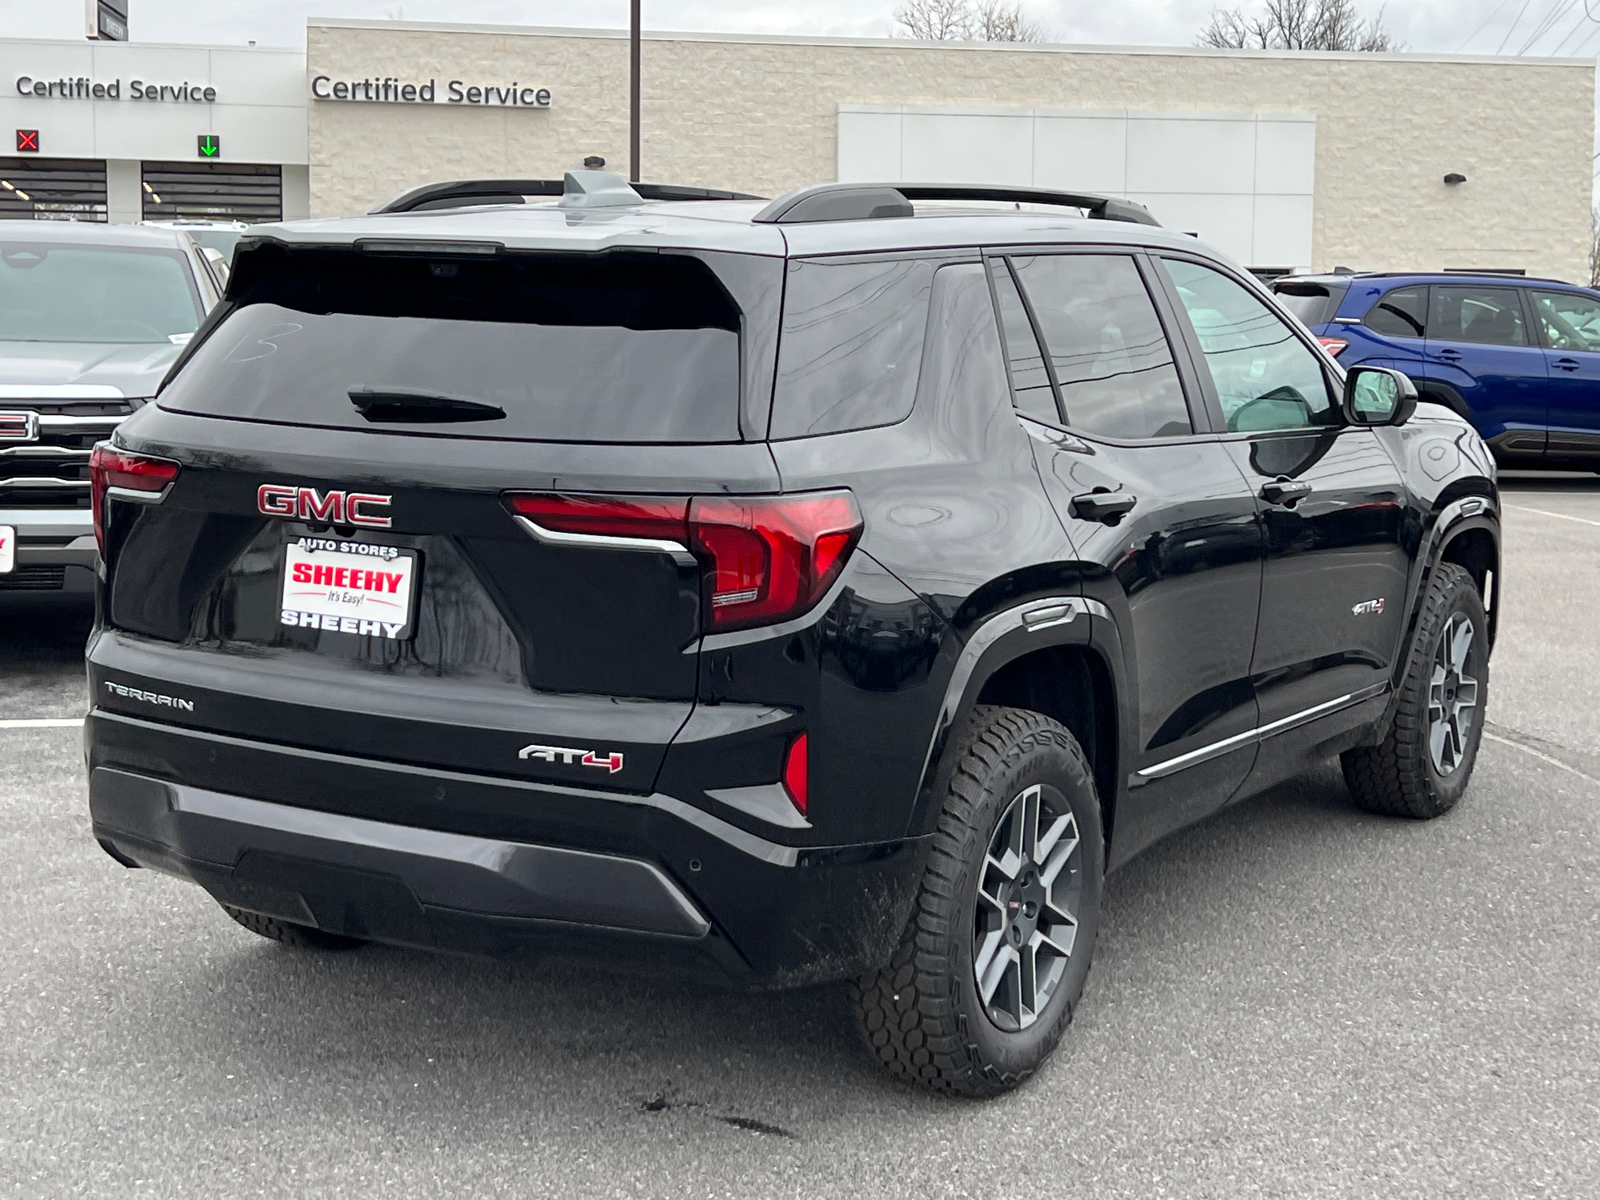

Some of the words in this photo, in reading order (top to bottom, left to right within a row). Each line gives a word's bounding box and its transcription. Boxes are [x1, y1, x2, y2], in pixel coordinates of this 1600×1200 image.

[16, 76, 120, 99] Certified
[130, 80, 216, 102] Service
[311, 75, 435, 102] Certified
[447, 80, 551, 106] Service
[257, 484, 393, 528] GMC
[297, 537, 337, 550] AUTO
[340, 541, 398, 558] STORES
[292, 562, 404, 594] SHEEHY
[327, 590, 341, 602] It's
[342, 593, 365, 607] Easy!
[1351, 597, 1385, 616] AT4
[280, 609, 405, 639] SHEEHY
[104, 681, 194, 712] TERRAIN
[518, 744, 624, 774] AT4
